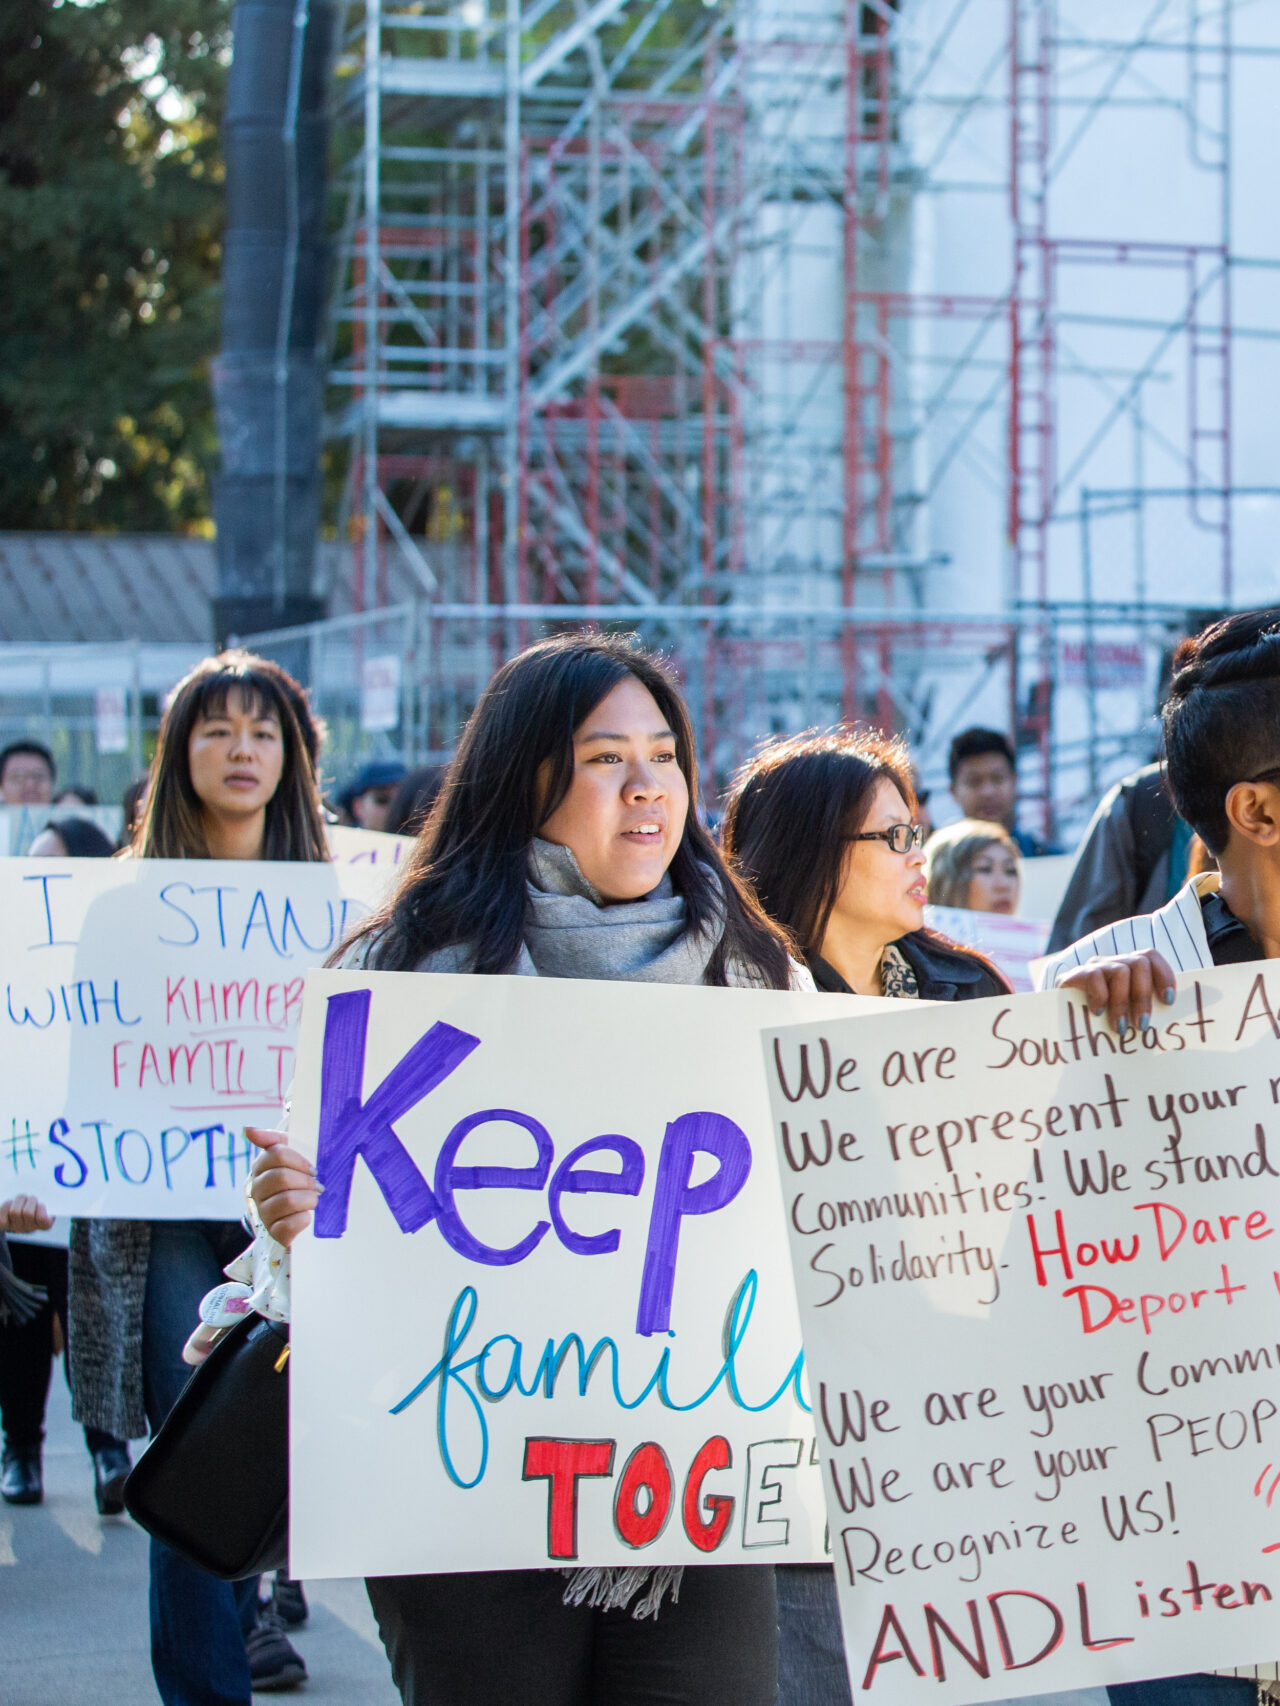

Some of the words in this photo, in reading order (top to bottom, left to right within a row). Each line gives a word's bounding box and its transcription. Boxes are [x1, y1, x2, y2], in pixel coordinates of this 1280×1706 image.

[23, 873, 78, 951] I
[7, 979, 142, 1029] WITH
[774, 1036, 860, 1102] We
[881, 1045, 957, 1088] are
[985, 980, 1215, 1069] Southeast
[113, 1038, 298, 1102] FAMILI
[1, 1117, 258, 1190] #STOPTH
[780, 1117, 864, 1173] We
[887, 1073, 1130, 1173] represent
[1147, 1082, 1249, 1152] your
[1063, 1149, 1132, 1198] We
[1143, 1122, 1280, 1192] stand
[313, 988, 752, 1336] Keep
[1026, 1208, 1140, 1288] How
[1133, 1201, 1275, 1262] Dare
[1062, 1262, 1248, 1336] Deport
[819, 1380, 901, 1447] We
[924, 1386, 1004, 1426] are
[1023, 1371, 1115, 1438] your
[521, 1434, 833, 1561] TOGE
[829, 1456, 914, 1514] We
[932, 1457, 1015, 1492] are
[1033, 1444, 1119, 1503] your
[840, 1520, 1080, 1587] Recognize
[860, 1588, 1066, 1691] AND
[1076, 1559, 1272, 1652] Listen
